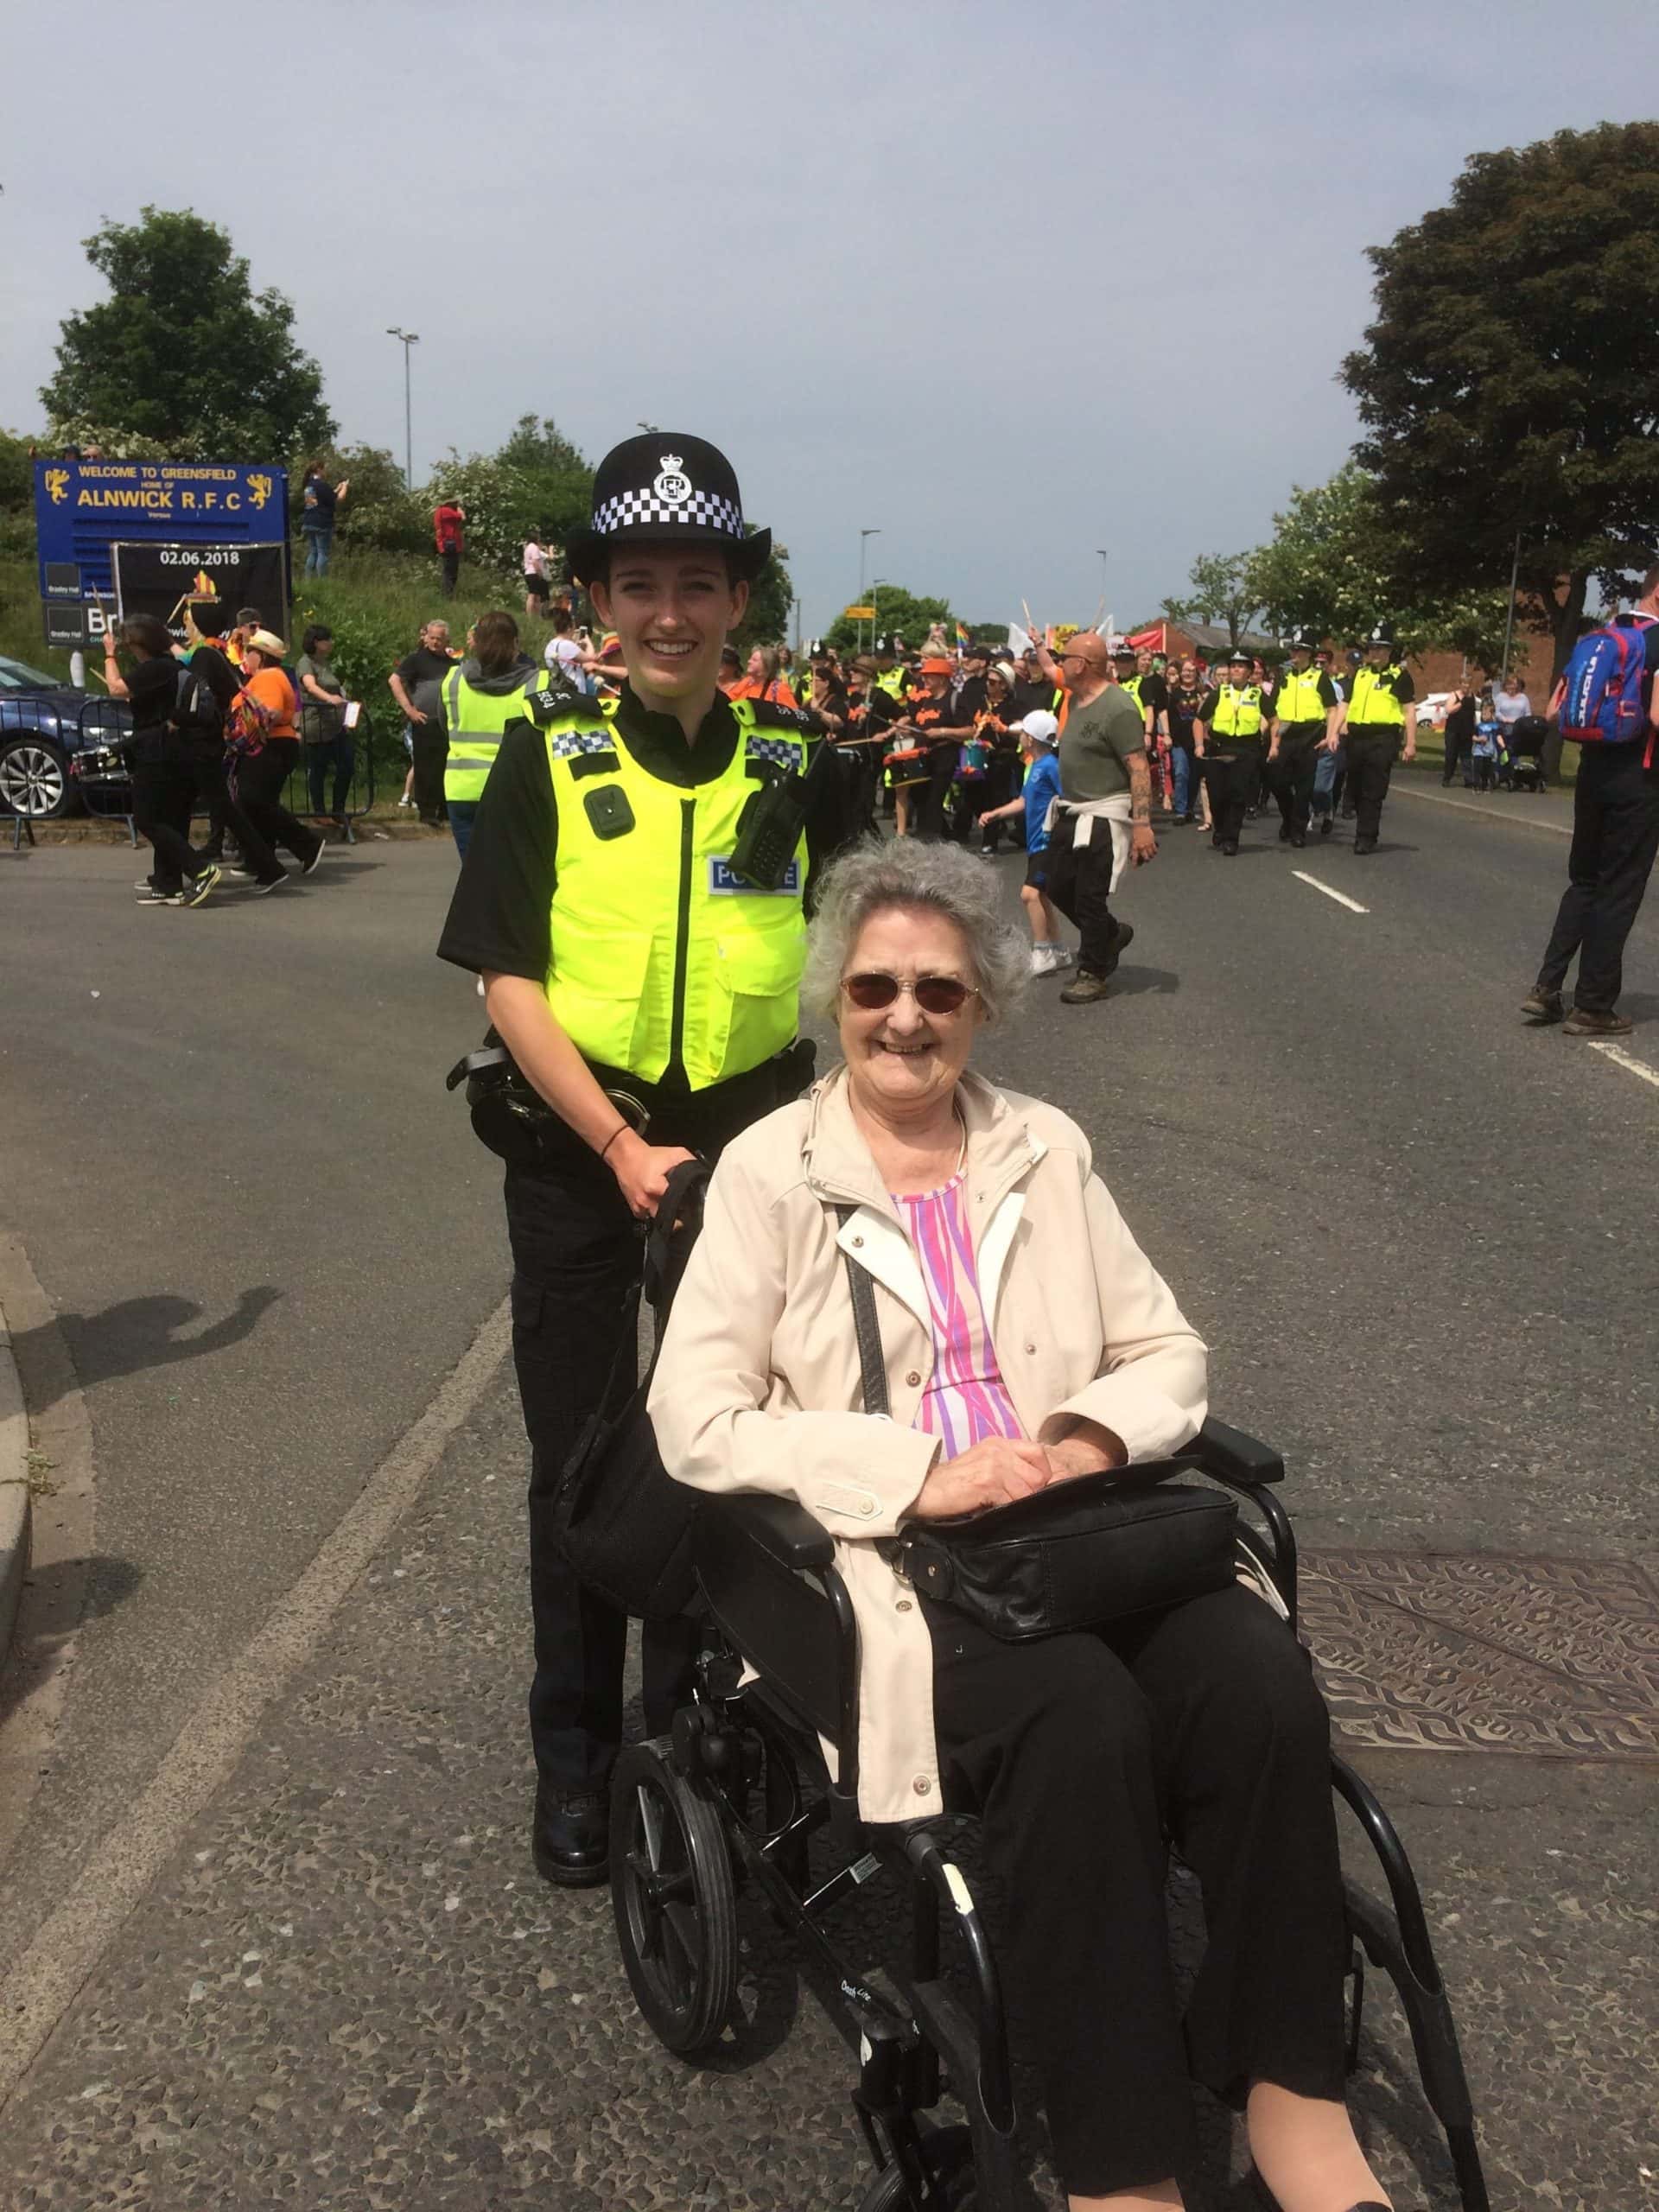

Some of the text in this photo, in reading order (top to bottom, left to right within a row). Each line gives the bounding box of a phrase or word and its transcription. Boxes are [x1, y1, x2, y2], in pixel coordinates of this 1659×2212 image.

[79, 466, 237, 480] WELCOME TO GREENSFIELD
[78, 489, 241, 511] ALNWICK R.F.C
[160, 551, 240, 565] 02.06.2018
[718, 865, 795, 885] POE
[1365, 1618, 1503, 1677] STANTON
[1481, 1614, 1624, 1675] STANTON
